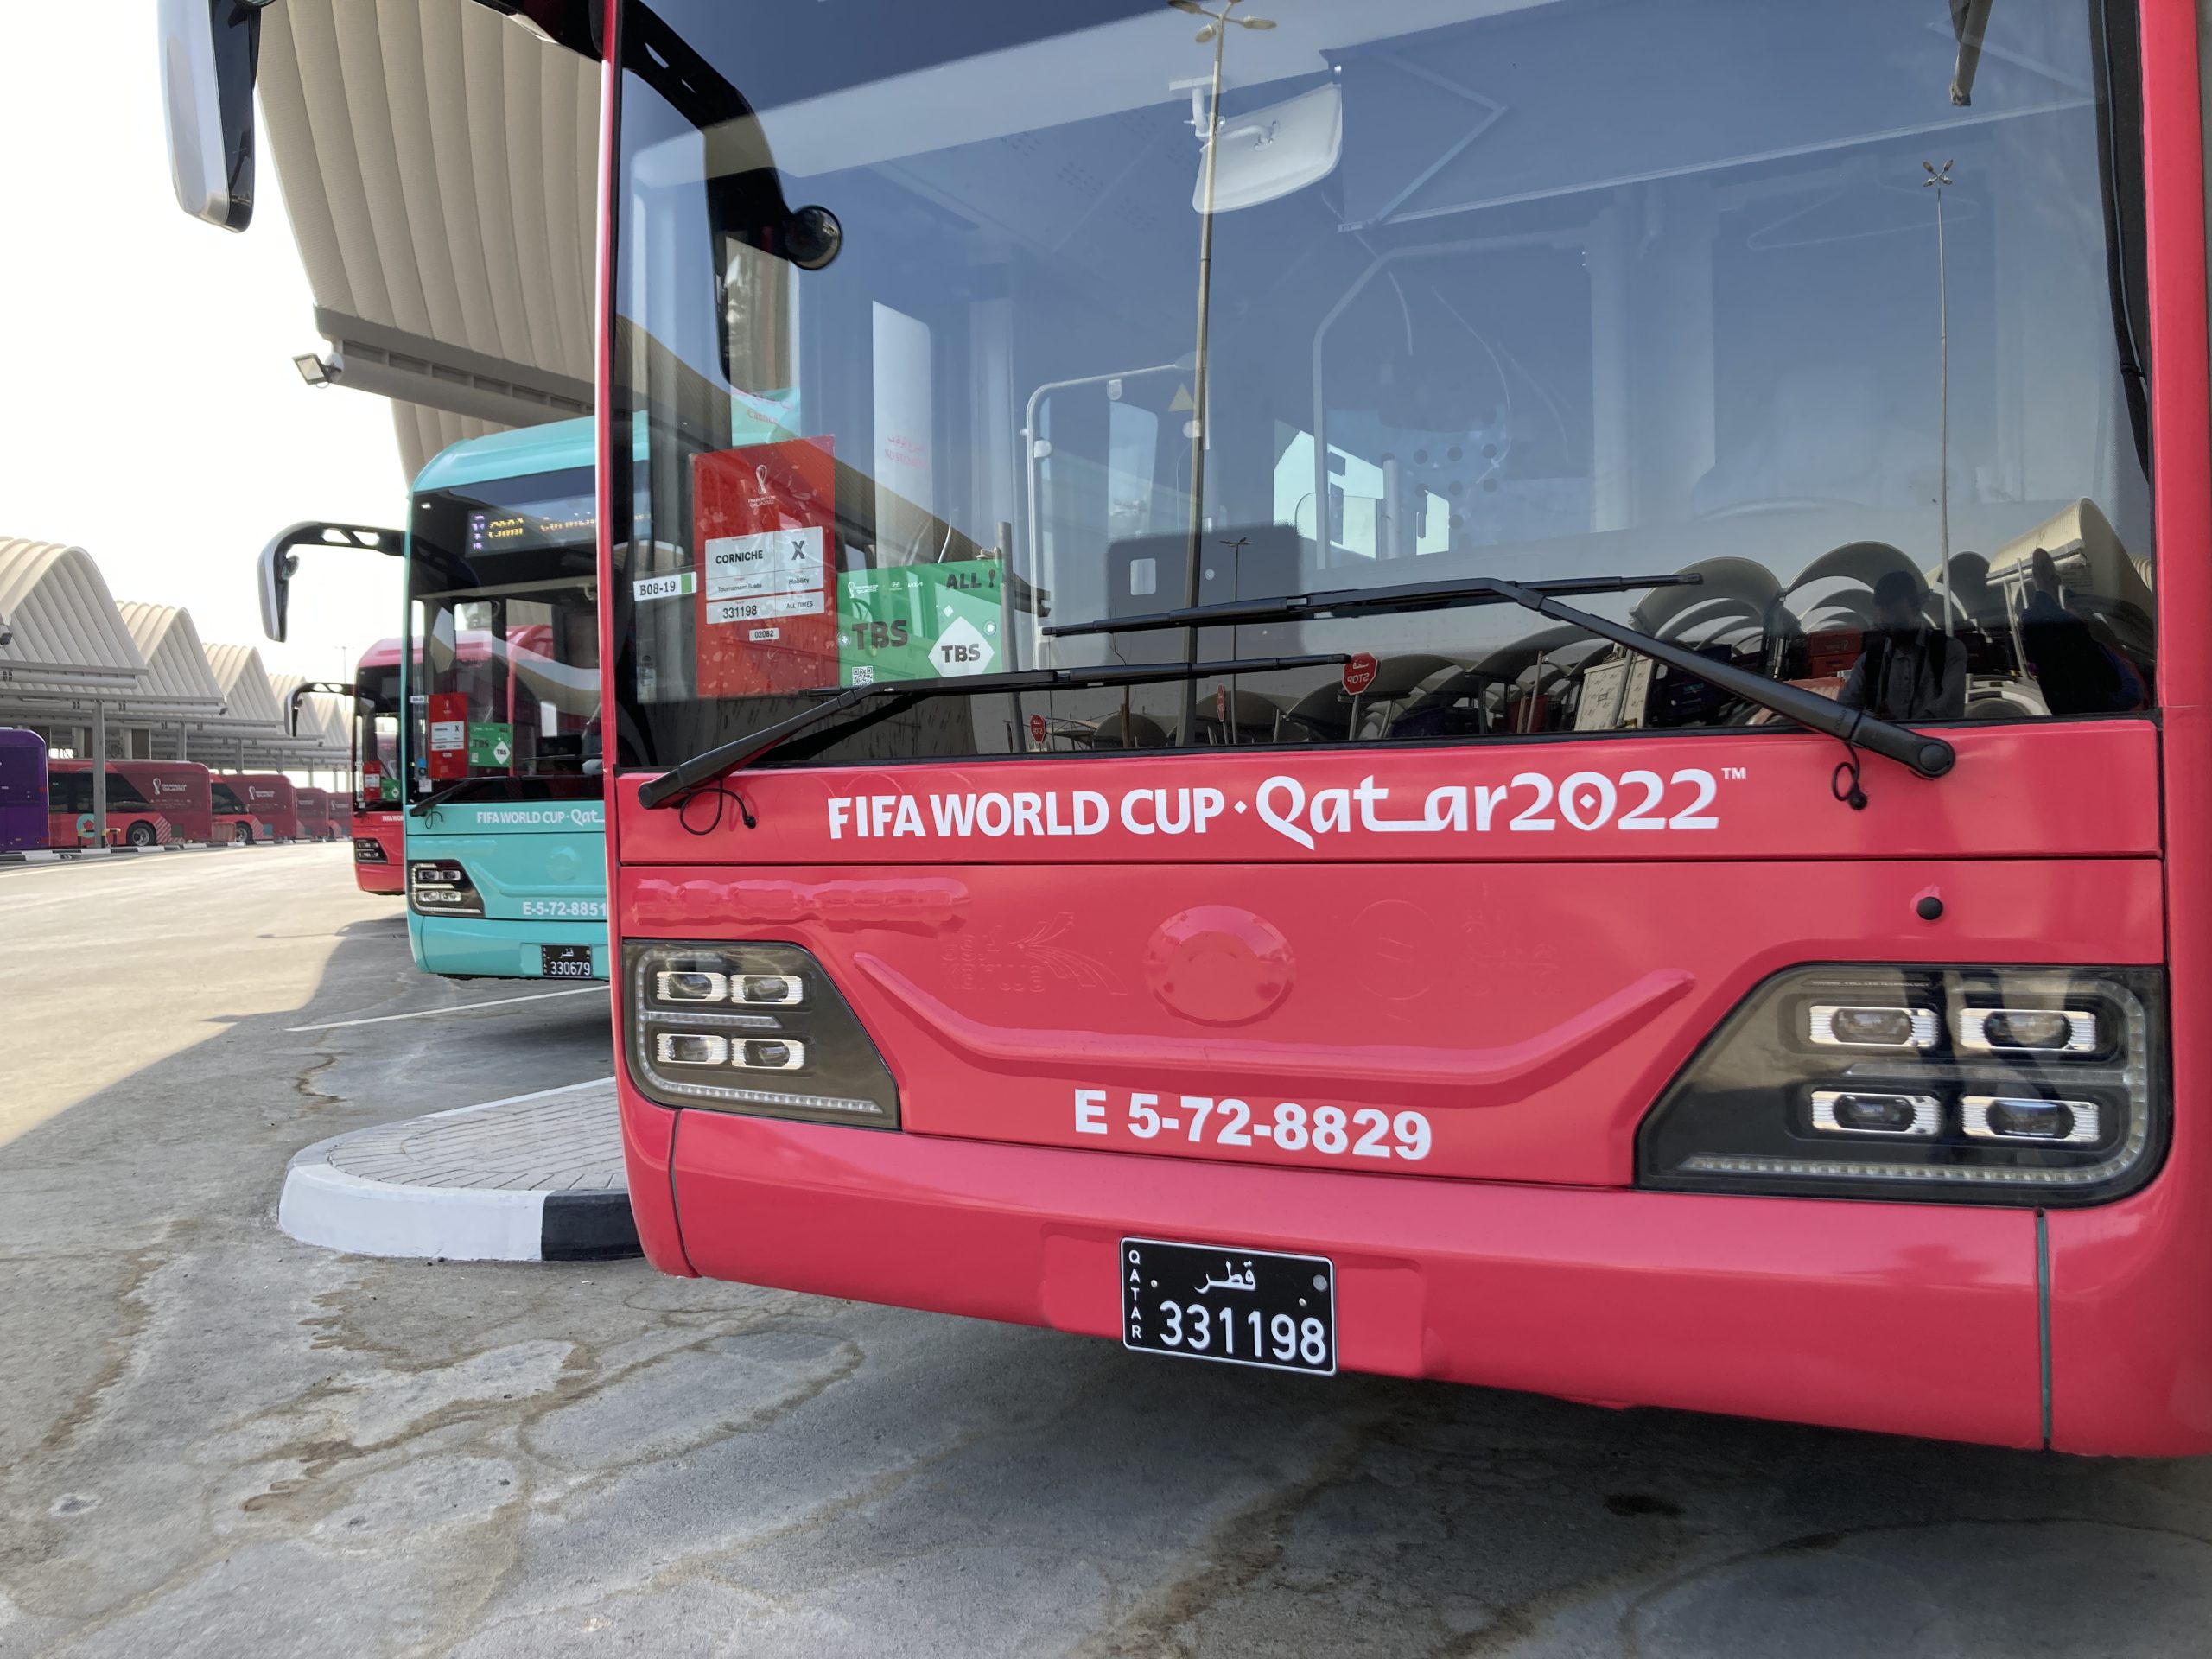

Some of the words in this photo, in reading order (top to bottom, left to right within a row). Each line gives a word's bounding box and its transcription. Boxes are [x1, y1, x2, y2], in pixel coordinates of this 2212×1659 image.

[715, 550, 764, 564] CORNICHE
[791, 540, 805, 561] X
[639, 581, 676, 596] B08-19
[945, 572, 982, 590] ALL
[722, 605, 758, 619] 331198
[851, 619, 908, 651] TBS
[941, 644, 981, 664] TBS
[476, 811, 499, 823] FIFA
[499, 811, 541, 823] WORLD
[542, 810, 565, 823] CUP
[828, 793, 926, 840] FIFA
[928, 791, 1110, 837] WORLD
[1120, 787, 1225, 836] CUP
[522, 901, 607, 917] E-5-72-8851
[550, 961, 591, 976] 330679
[1074, 1088, 1108, 1135] E
[1128, 1091, 1432, 1161] 5-72-8829
[1193, 1260, 1256, 1294] قطر
[1128, 1249, 1143, 1340] QATAR
[1159, 1300, 1326, 1365] 331198
